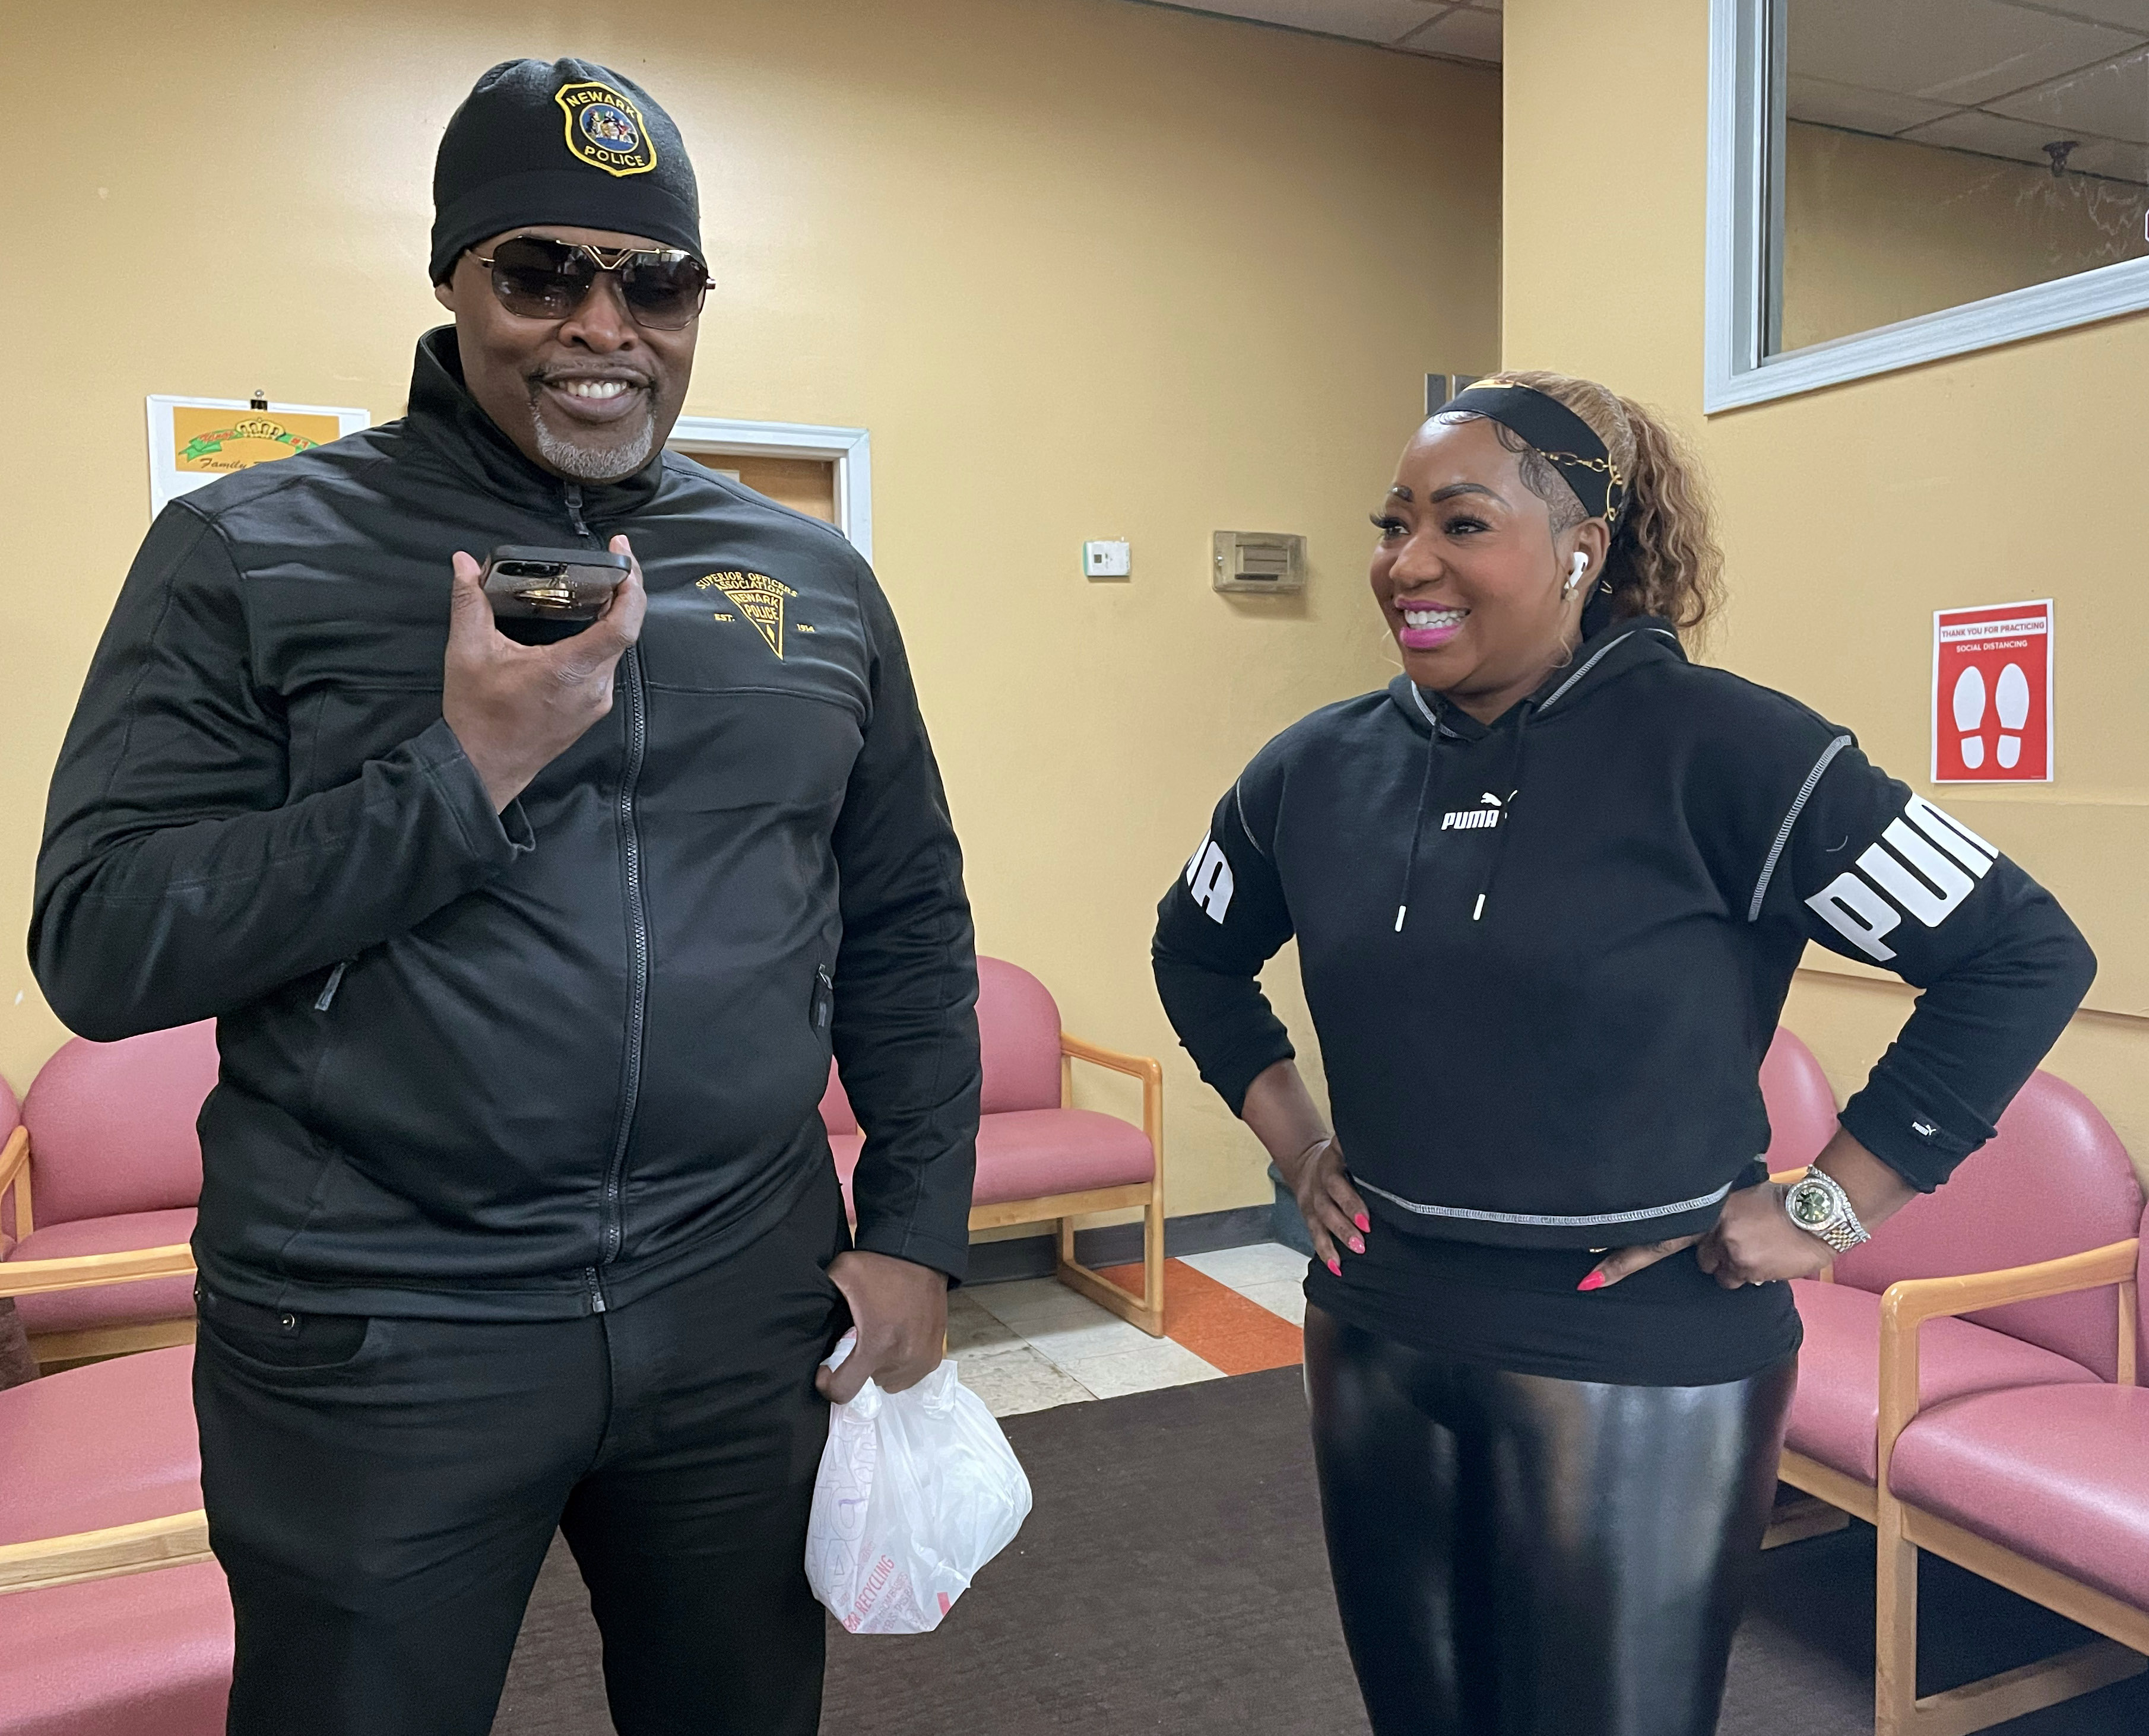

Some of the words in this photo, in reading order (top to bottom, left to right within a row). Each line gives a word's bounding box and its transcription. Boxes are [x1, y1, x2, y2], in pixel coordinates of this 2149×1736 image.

[566, 90, 635, 119] NEWARK
[584, 145, 645, 166] POLICE
[695, 572, 744, 589] SUPERIOR
[747, 573, 798, 598] OFFICERS
[715, 580, 784, 596] ASSOCIATION
[731, 593, 779, 608] NEWARK
[743, 604, 779, 621] POLICE
[1942, 630, 1966, 638] THANK
[1967, 627, 1983, 636] YOU
[2001, 621, 2045, 633] PRACTICING
[1956, 645, 1982, 653] SOCIAL
[1983, 639, 2028, 650] DISTANCING
[1441, 810, 1500, 830] PUMA
[854, 1554, 895, 1616] RECYCLING
